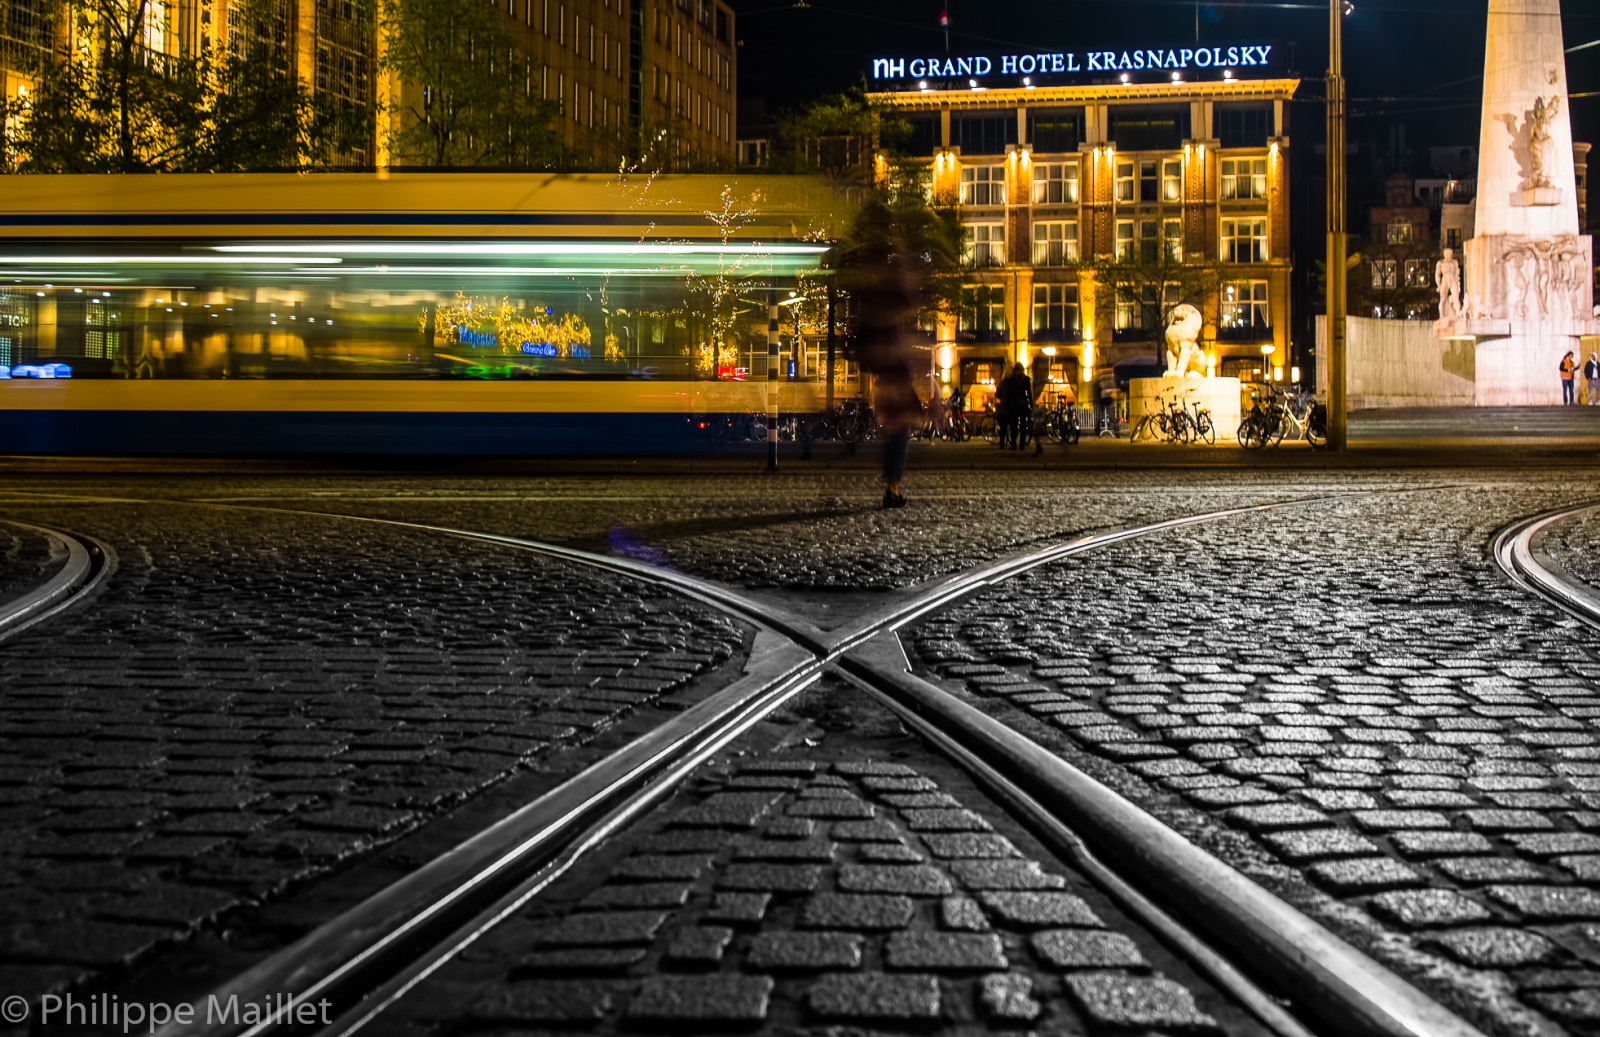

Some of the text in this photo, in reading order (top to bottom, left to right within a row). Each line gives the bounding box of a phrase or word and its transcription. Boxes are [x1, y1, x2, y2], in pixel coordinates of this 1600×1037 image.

[908, 56, 992, 79] GRAND
[1000, 52, 1081, 75] HOTEL
[1086, 45, 1272, 72] KRASNAPOLSKY
